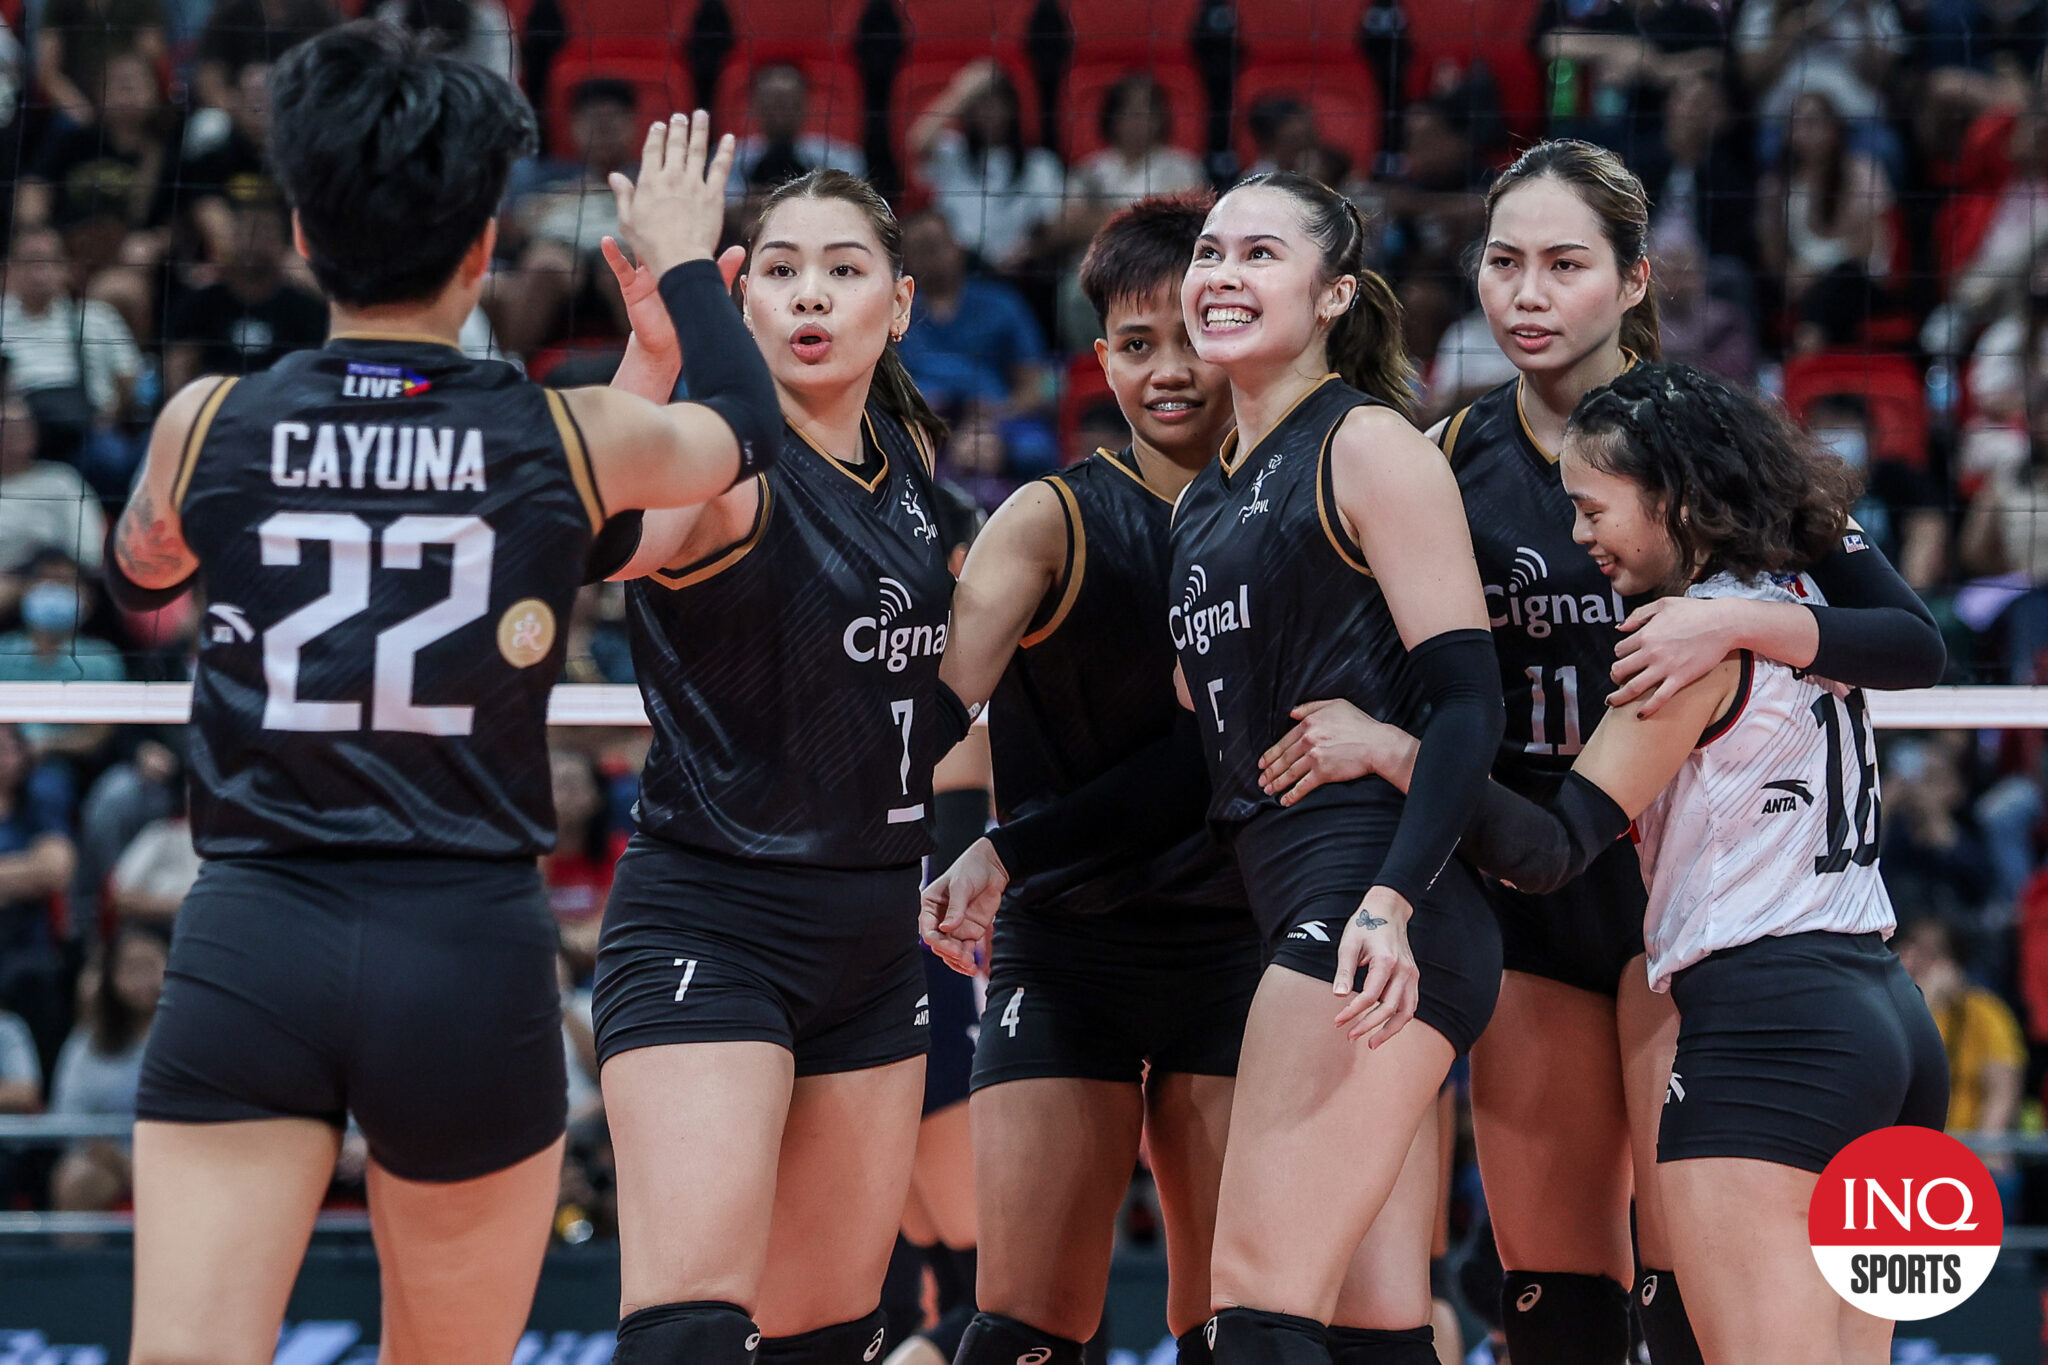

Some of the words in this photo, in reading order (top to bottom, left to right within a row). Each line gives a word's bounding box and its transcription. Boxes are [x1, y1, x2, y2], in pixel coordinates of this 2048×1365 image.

[271, 421, 487, 492] CAYUNA
[1252, 499, 1269, 514] PVL
[258, 510, 495, 737] 22
[1168, 584, 1251, 655] Cignal
[1484, 583, 1625, 638] Cignal
[1523, 665, 1586, 755] 11
[890, 698, 914, 796] 7
[1761, 796, 1797, 814] ANTA
[673, 958, 698, 1002] 7
[913, 1009, 930, 1026] ANT
[1000, 987, 1024, 1038] 4
